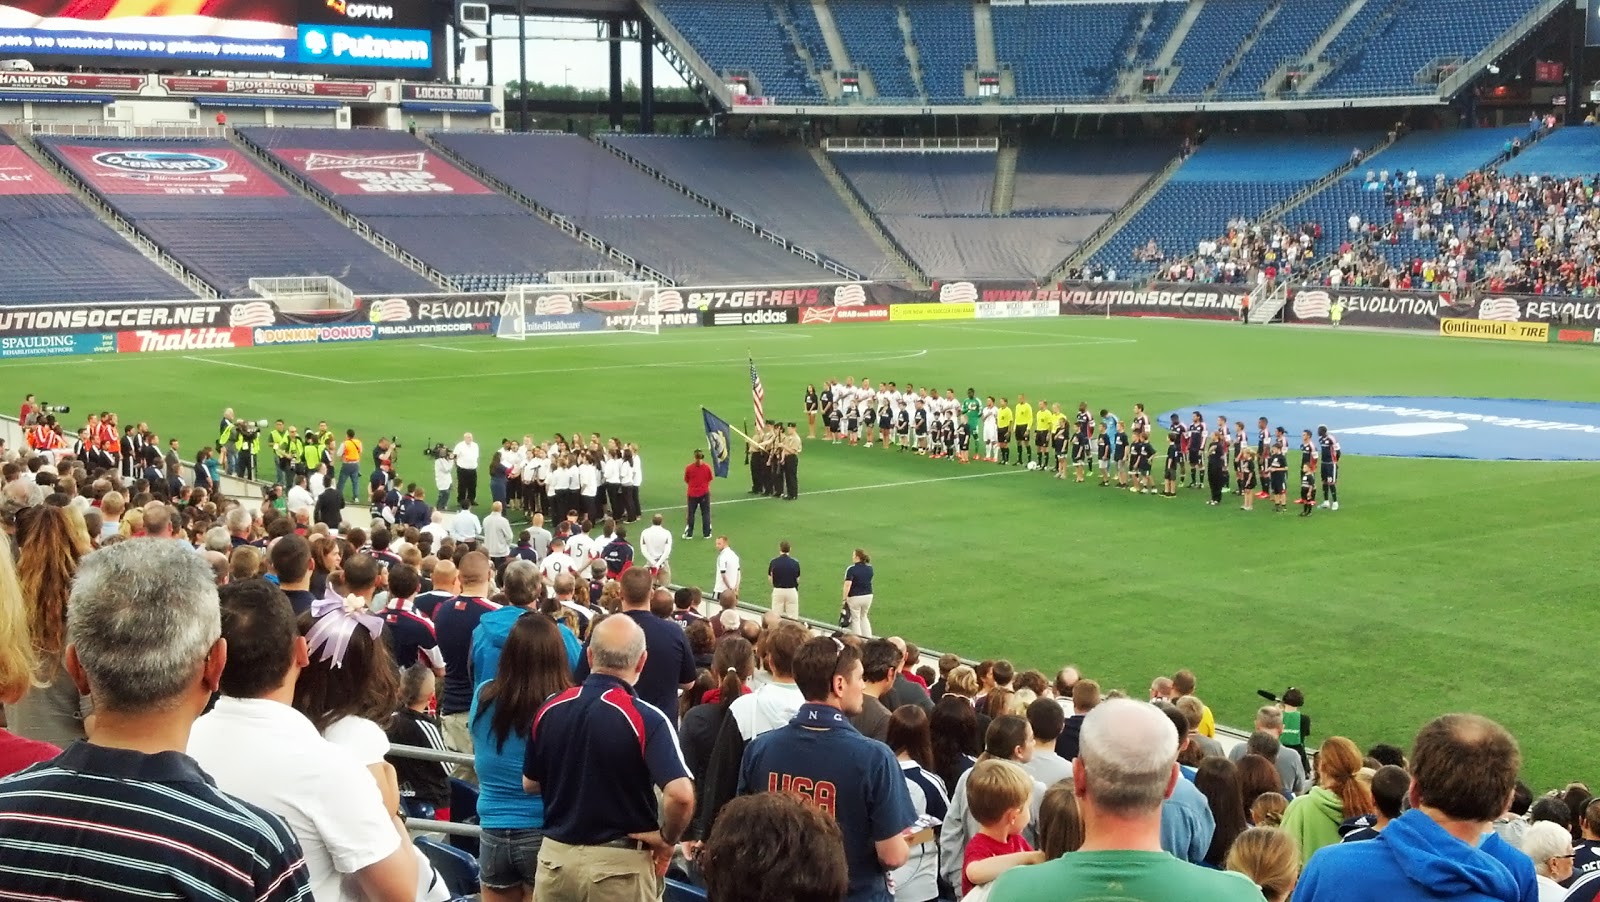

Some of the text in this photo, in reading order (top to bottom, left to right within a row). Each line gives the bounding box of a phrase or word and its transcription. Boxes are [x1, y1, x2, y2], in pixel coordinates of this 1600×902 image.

[347, 4, 394, 19] OPTUM
[331, 32, 429, 60] Putnam
[226, 80, 315, 94] SMOKEHOUSE
[106, 156, 161, 169] Ocean
[305, 154, 428, 168] Budweiser
[982, 290, 1249, 309] WWW.REVOLUTIONSOCCER.NE
[1338, 295, 1438, 315] REVOLUTION
[0, 305, 221, 330] UTIONSOCCER.NET
[418, 300, 523, 320] REVOLUTION
[743, 310, 787, 324] adidas
[837, 310, 857, 318] GRAB
[321, 326, 375, 341] DONUTS
[1442, 319, 1546, 338] Continental TIRE
[2, 335, 74, 349] SPAULDING
[575, 543, 583, 557] 5
[552, 561, 562, 574] 9
[768, 771, 837, 820] USA
